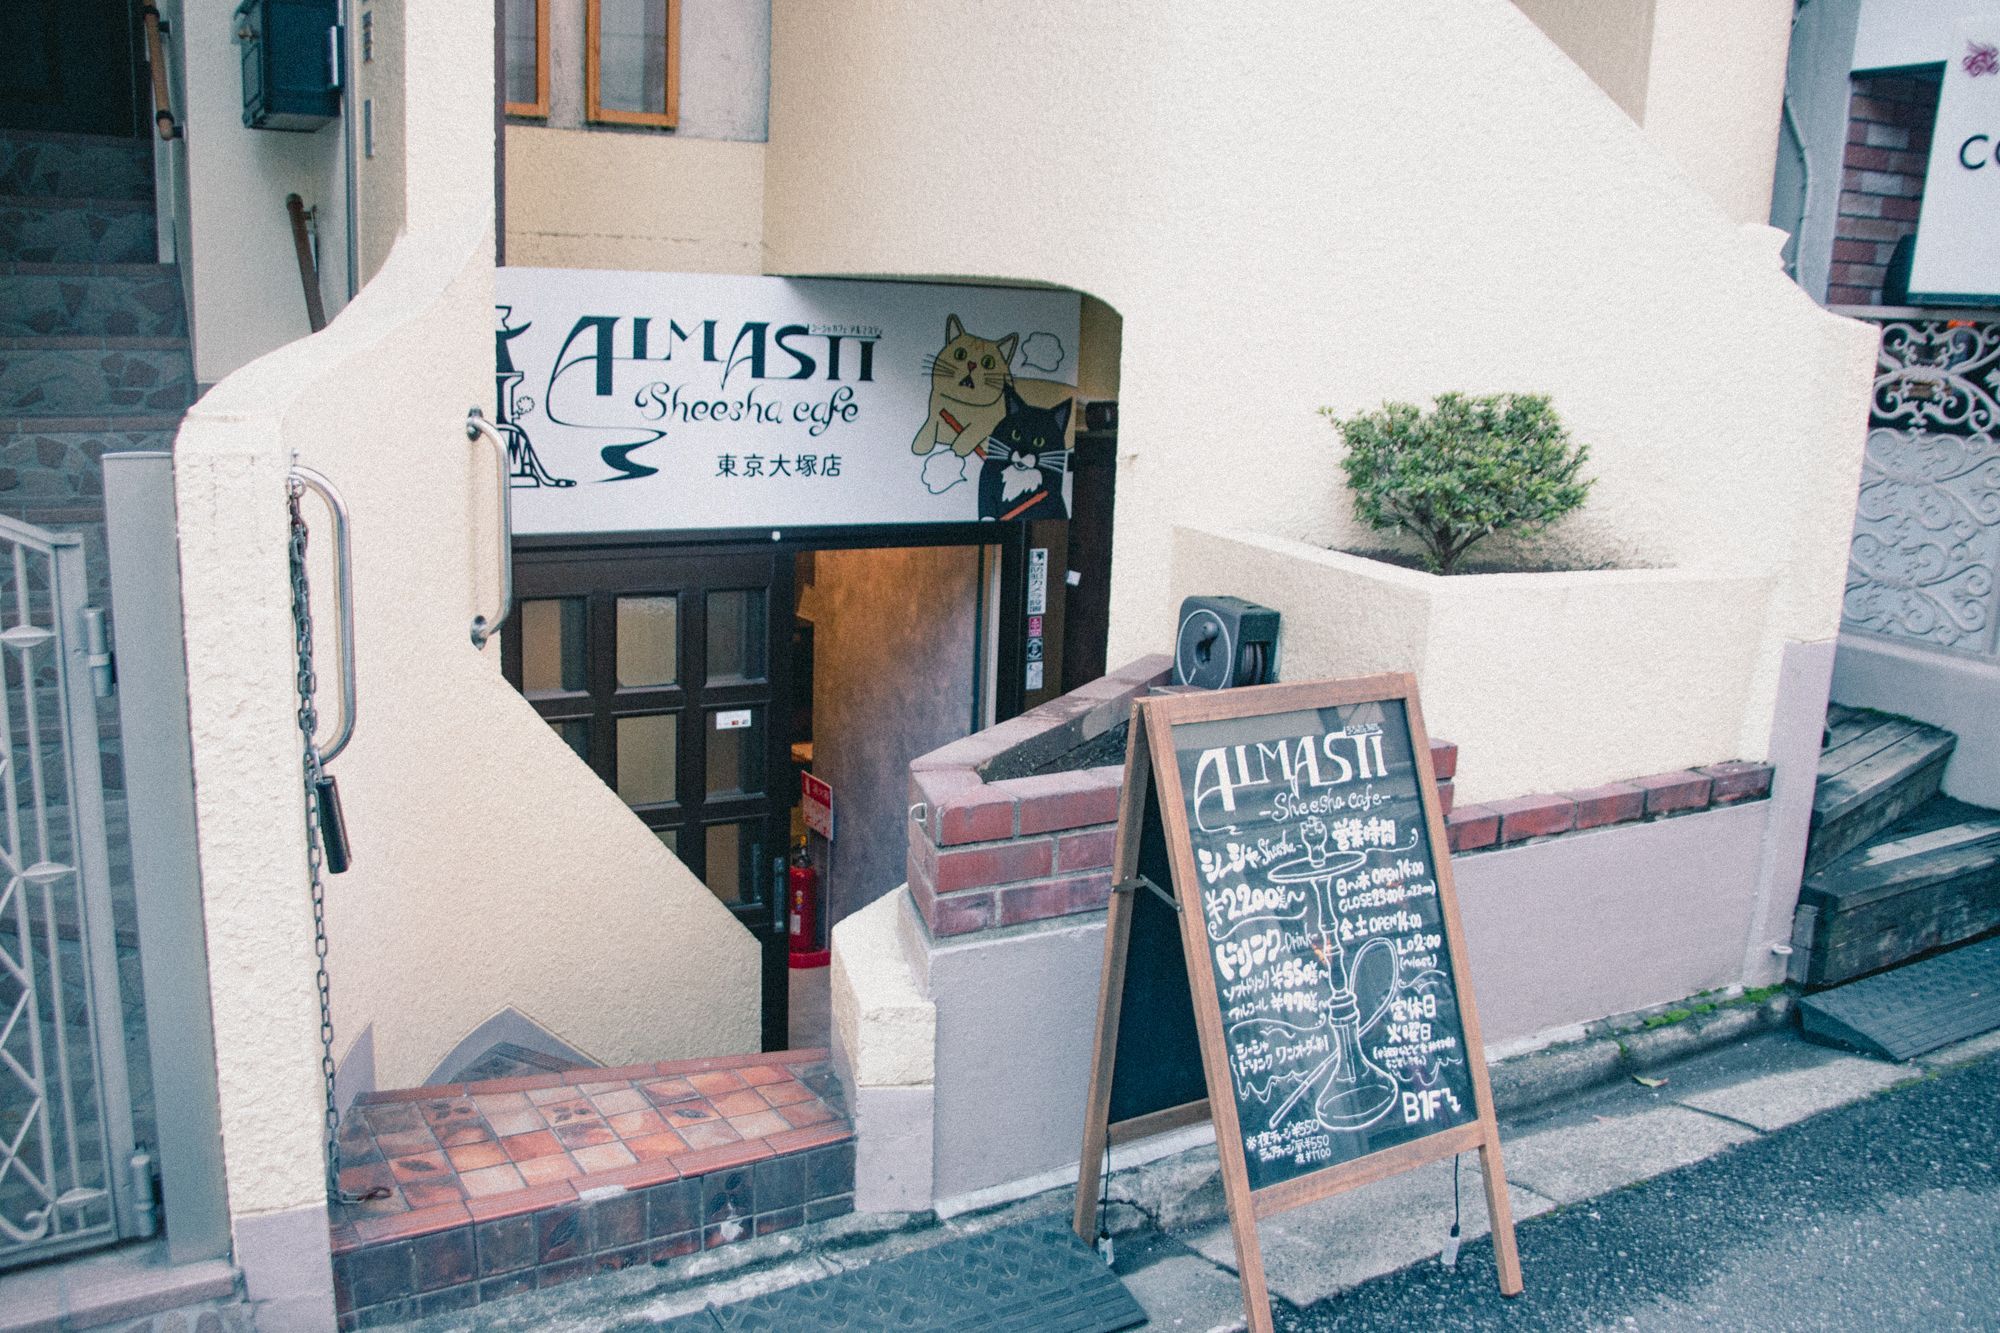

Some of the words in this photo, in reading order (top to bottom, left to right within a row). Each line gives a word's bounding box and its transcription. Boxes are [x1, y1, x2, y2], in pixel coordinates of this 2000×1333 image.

[1960, 134, 2000, 170] C
[635, 381, 783, 423] Sheesha
[715, 453, 843, 477] 東京大塚店
[1216, 929, 1281, 981] ドリンク
[1228, 997, 1269, 1020] アルコール
[1390, 994, 1437, 1021] 定休日
[1386, 1022, 1431, 1044] 火曜日
[1402, 1089, 1442, 1124] B1F
